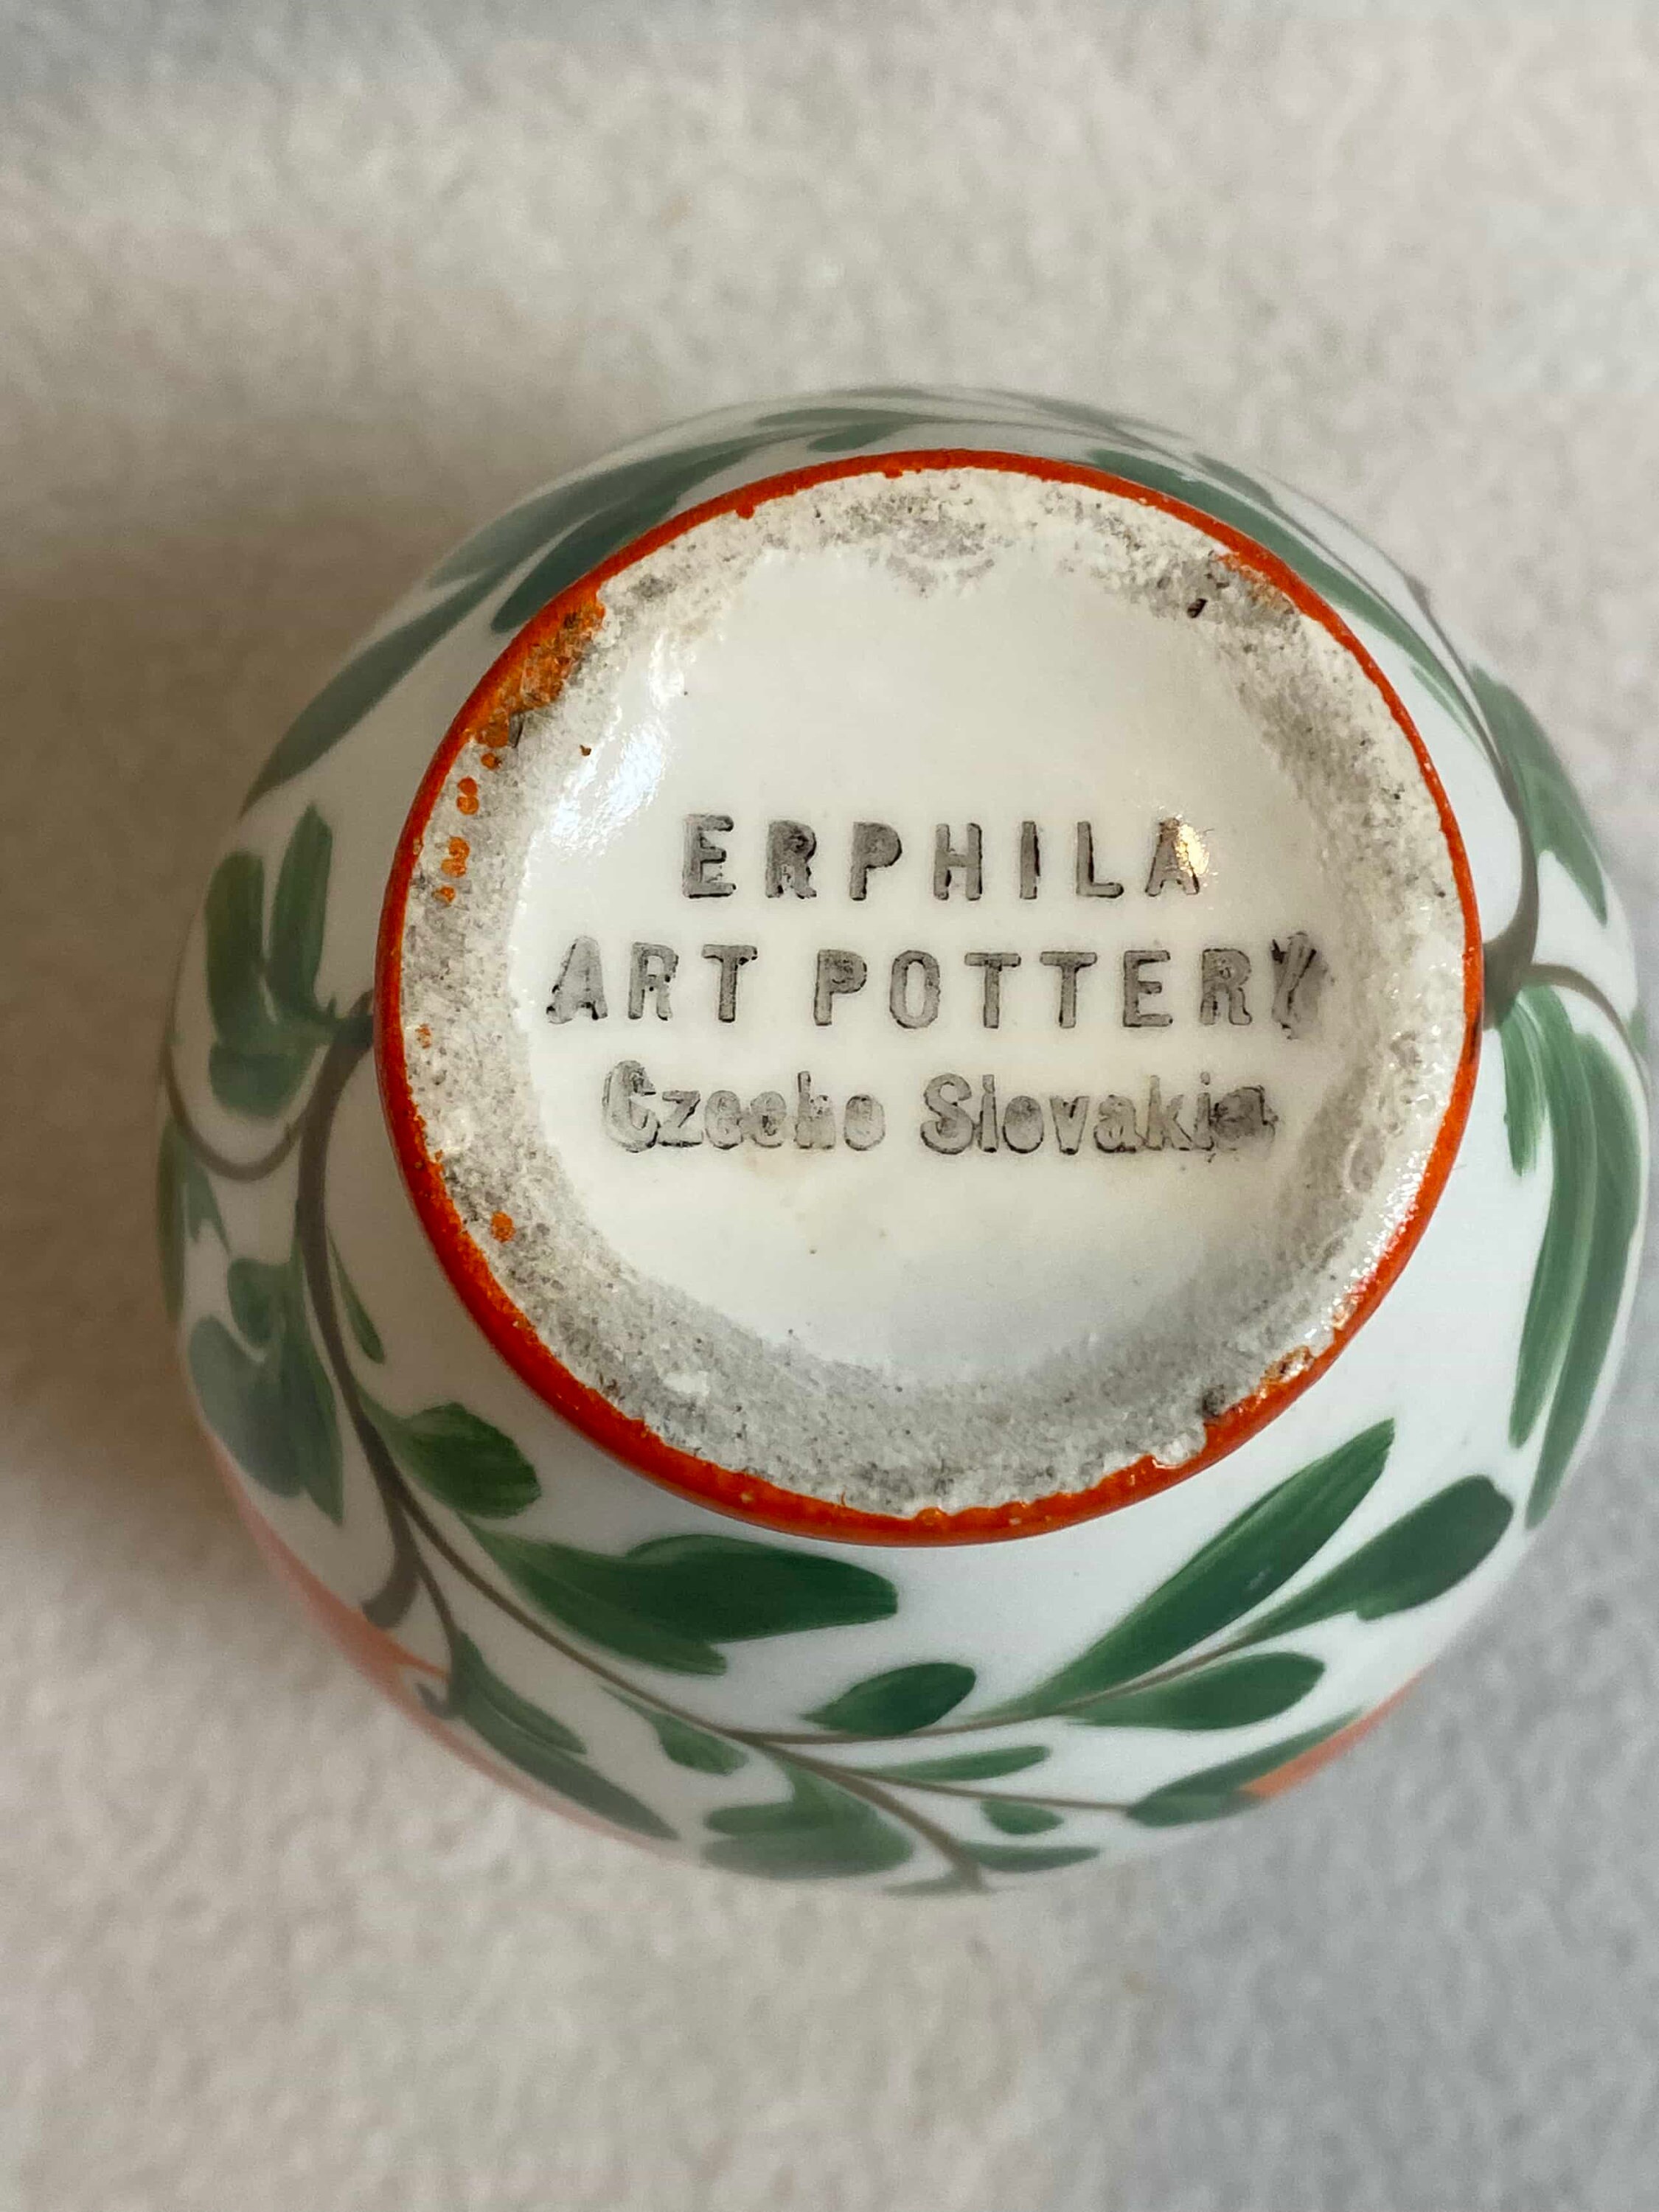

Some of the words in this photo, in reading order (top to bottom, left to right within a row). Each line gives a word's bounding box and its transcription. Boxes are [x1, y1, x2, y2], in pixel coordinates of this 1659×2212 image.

[682, 814, 1202, 901] ERPHILA
[546, 935, 758, 1024] ART
[813, 932, 1326, 1036] POTTERY
[919, 1071, 1277, 1155] Slovakia
